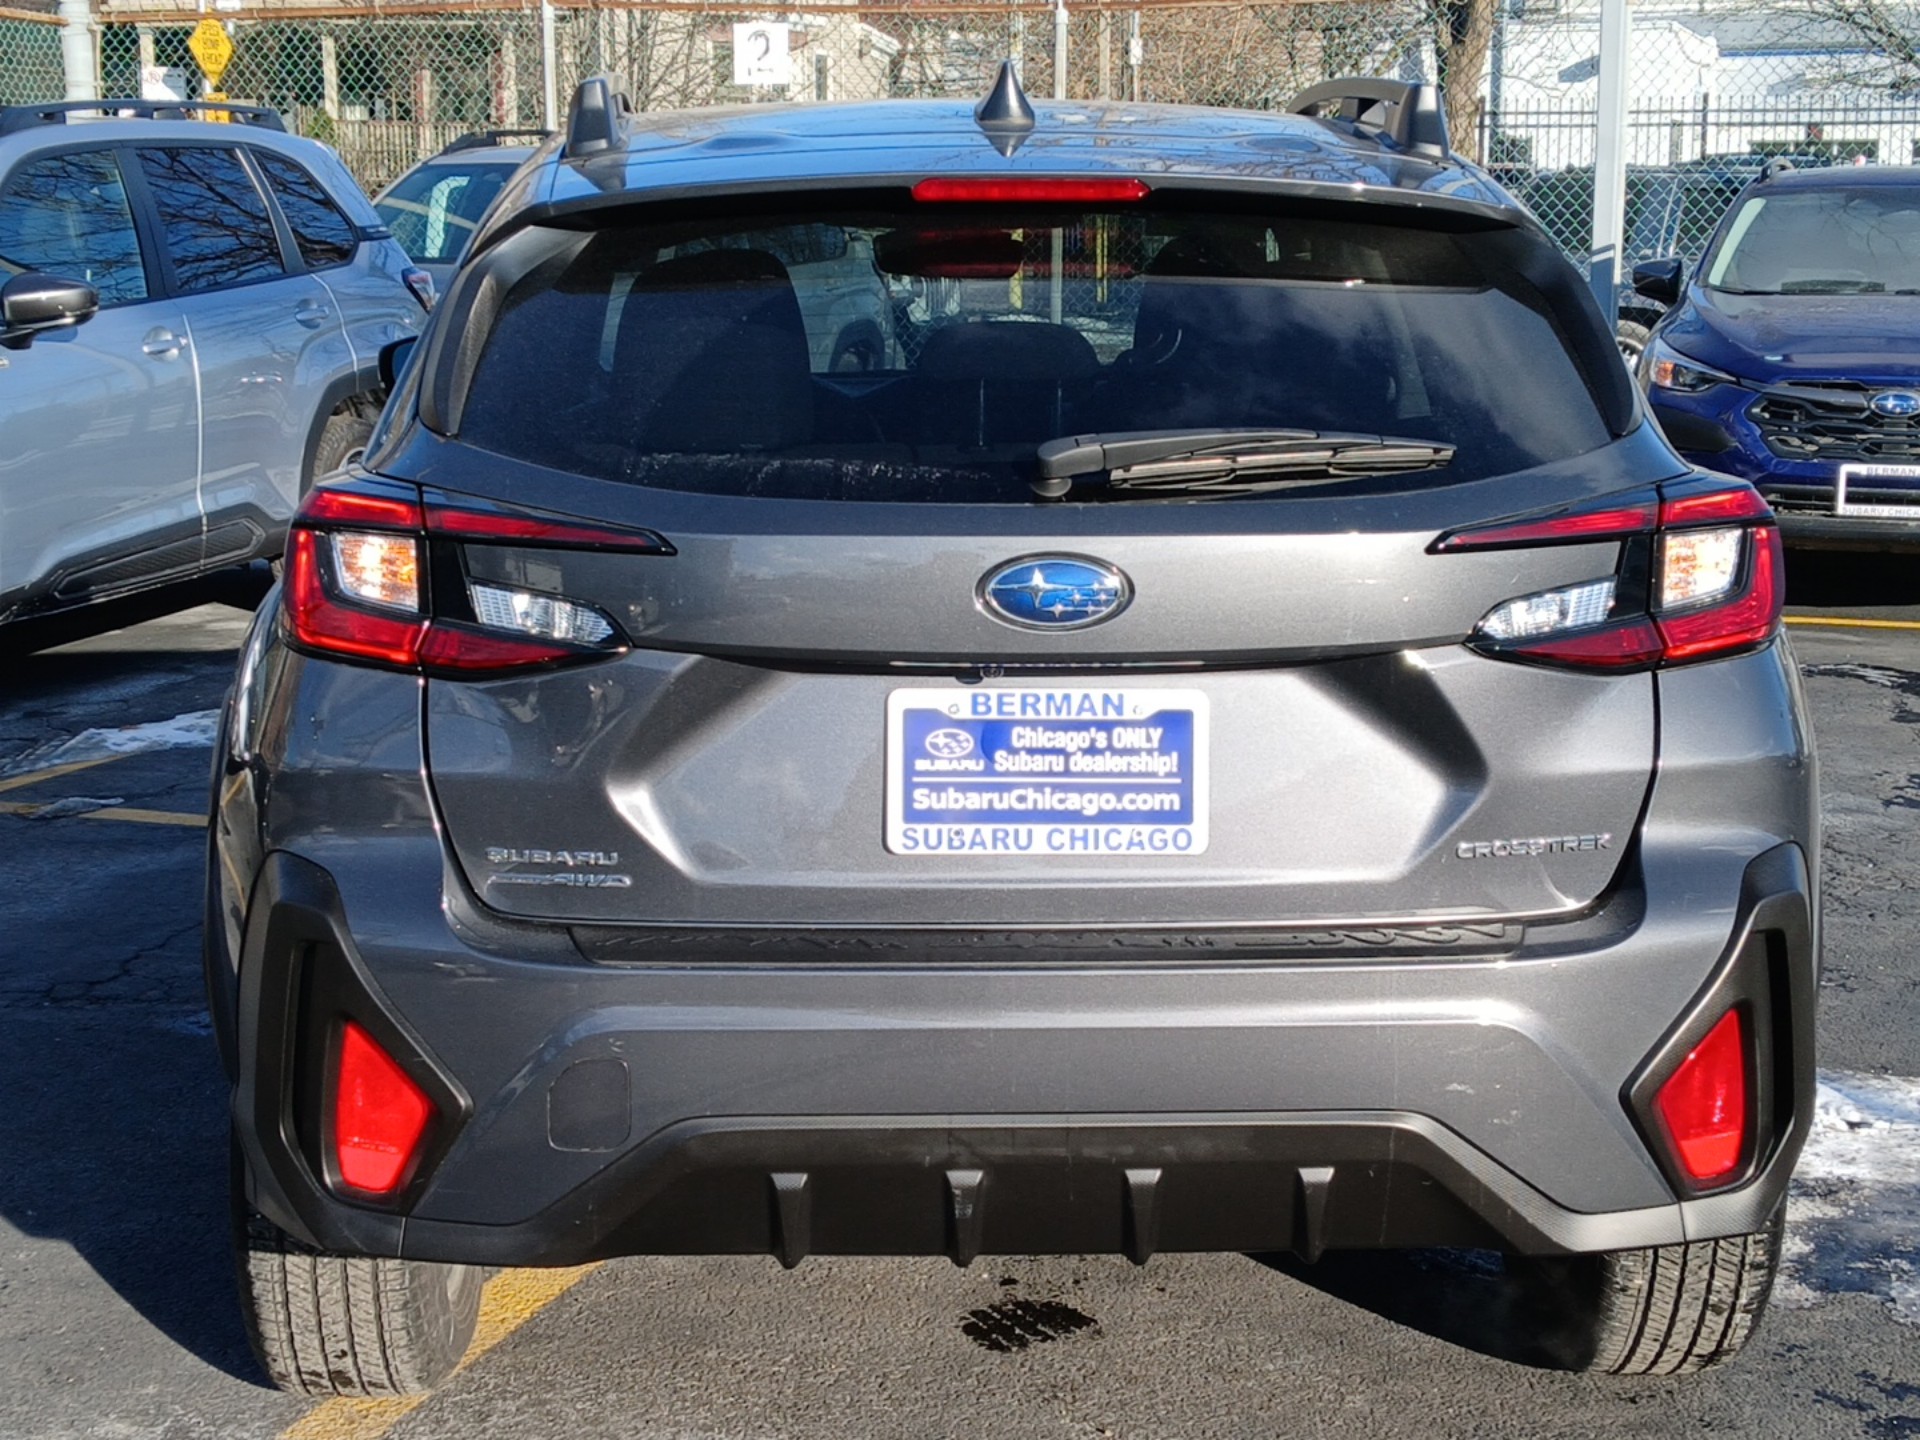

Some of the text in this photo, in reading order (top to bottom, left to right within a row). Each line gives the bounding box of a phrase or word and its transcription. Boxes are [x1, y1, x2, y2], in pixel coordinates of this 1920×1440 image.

[1866, 466, 1916, 476] BERMAN
[1842, 507, 1885, 515] SUBARU
[971, 692, 1124, 716] BERMAN
[1011, 726, 1163, 752] Chicago's ONLY
[914, 758, 985, 771] SUBARU
[994, 749, 1178, 776] Subaru dealership!
[912, 786, 1181, 816] SubaruChicago.com
[901, 827, 1193, 851] SUBARU CHICAGO
[1456, 832, 1613, 859] CROSSTREK
[484, 846, 619, 866] SUBARU
[552, 872, 632, 888] AWD
